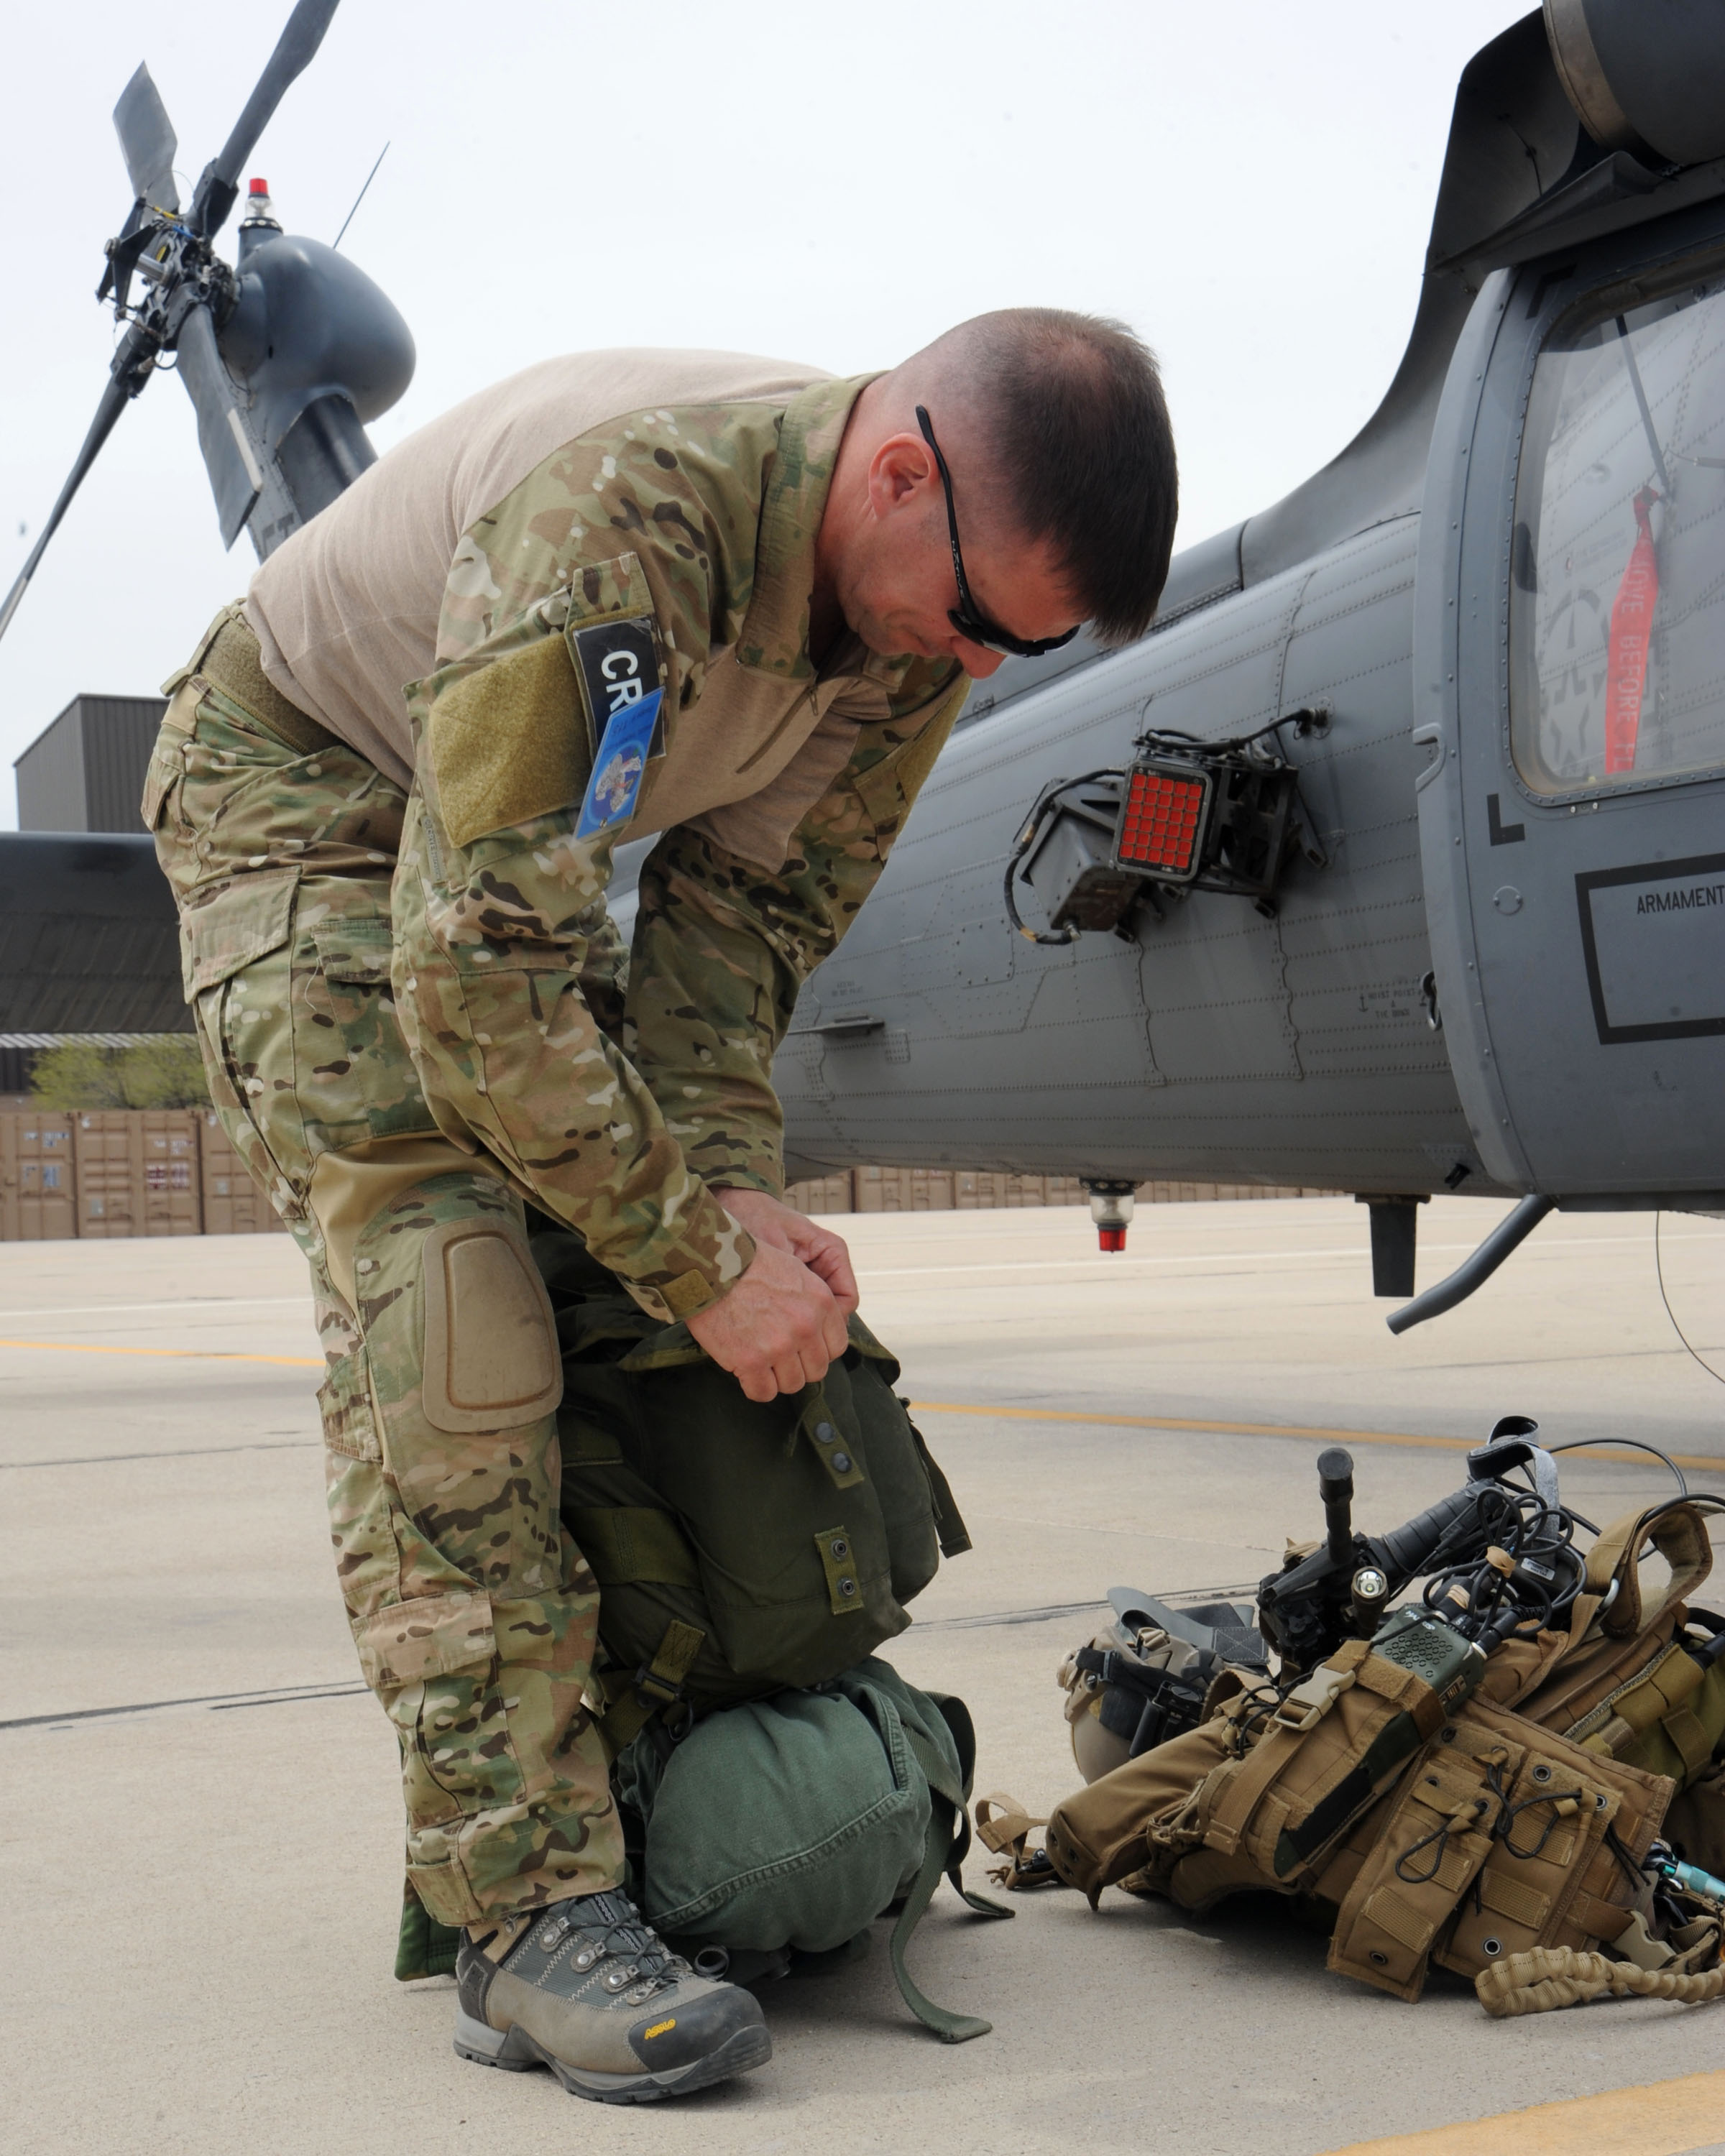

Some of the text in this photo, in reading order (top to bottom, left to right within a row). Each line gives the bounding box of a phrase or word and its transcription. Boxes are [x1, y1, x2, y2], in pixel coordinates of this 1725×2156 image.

[601, 650, 643, 712] CR
[1619, 635, 1642, 722] BEFORE
[1637, 884, 1725, 915] ARMAMENT
[644, 2018, 676, 2040] ASOLO
